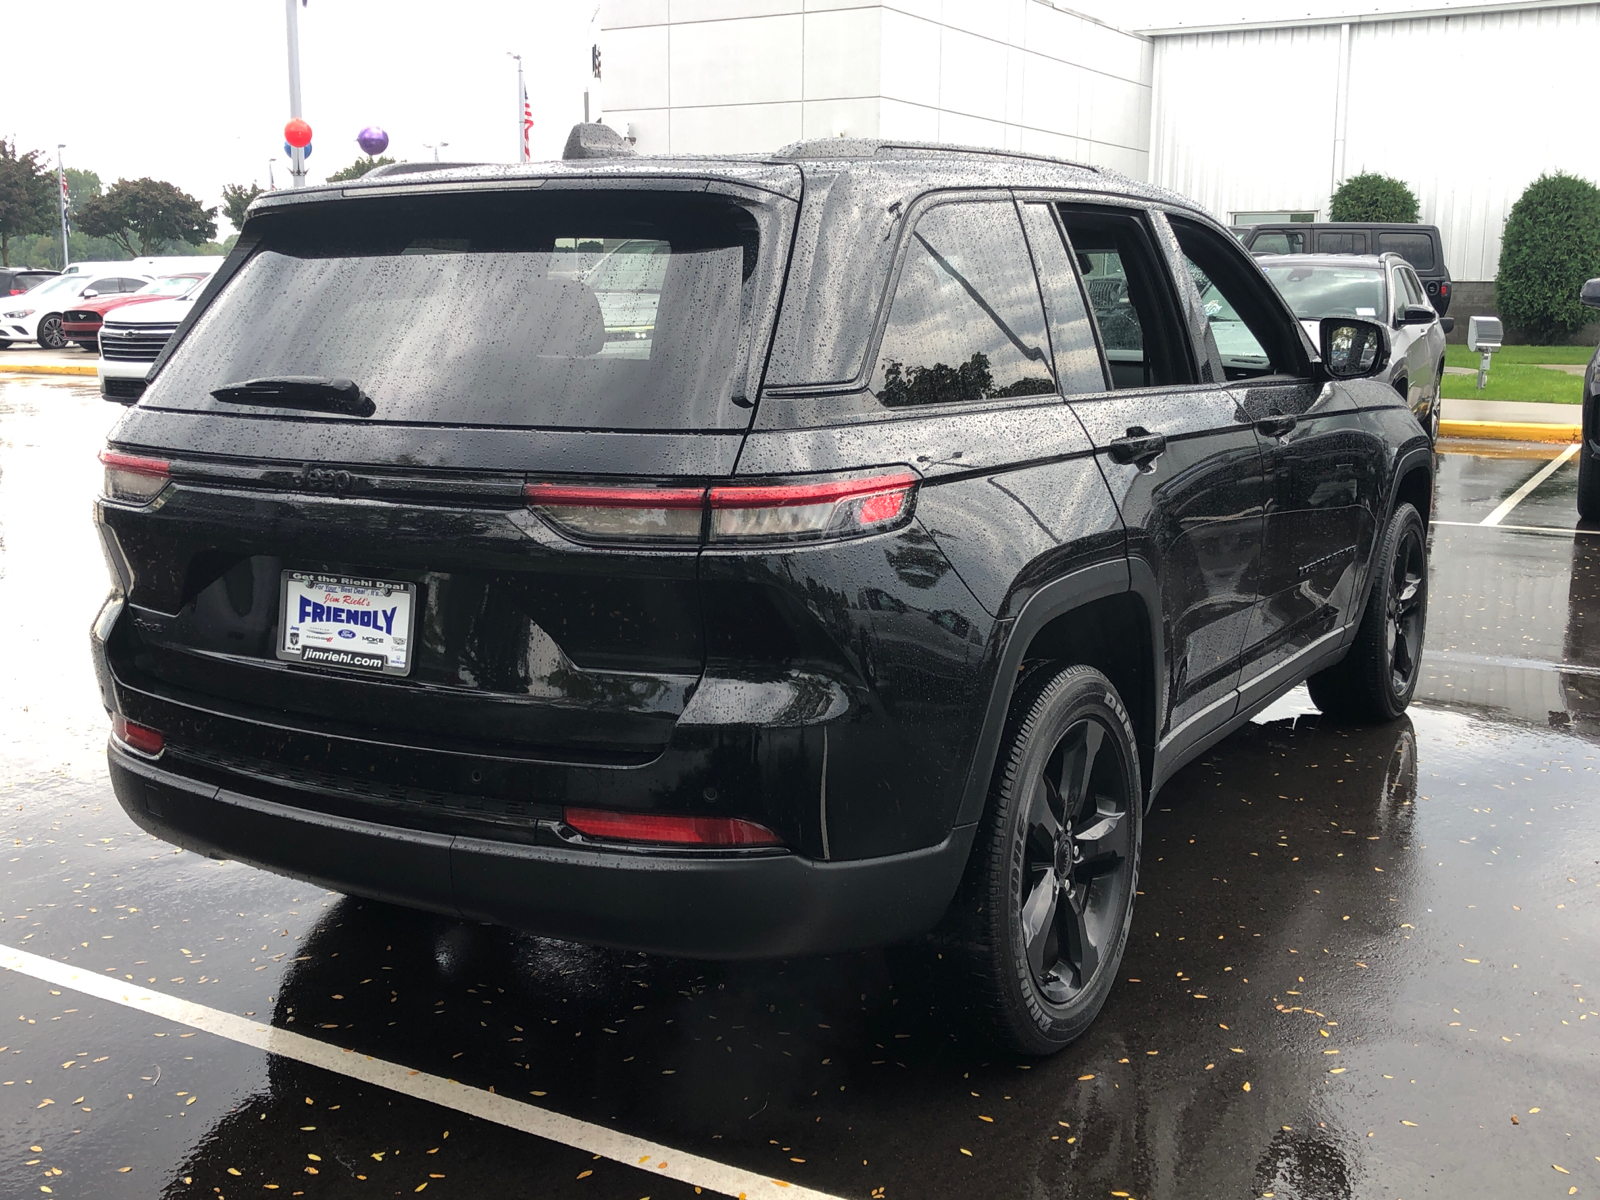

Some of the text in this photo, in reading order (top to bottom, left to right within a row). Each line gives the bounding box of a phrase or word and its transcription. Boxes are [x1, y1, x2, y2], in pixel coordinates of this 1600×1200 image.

[318, 575, 337, 583] the
[341, 578, 372, 587] Riehl
[376, 581, 404, 590] Deal
[324, 593, 371, 606] Jim Riehl's
[299, 594, 398, 636] FRIENDLY
[303, 648, 383, 668] jimriehl.com
